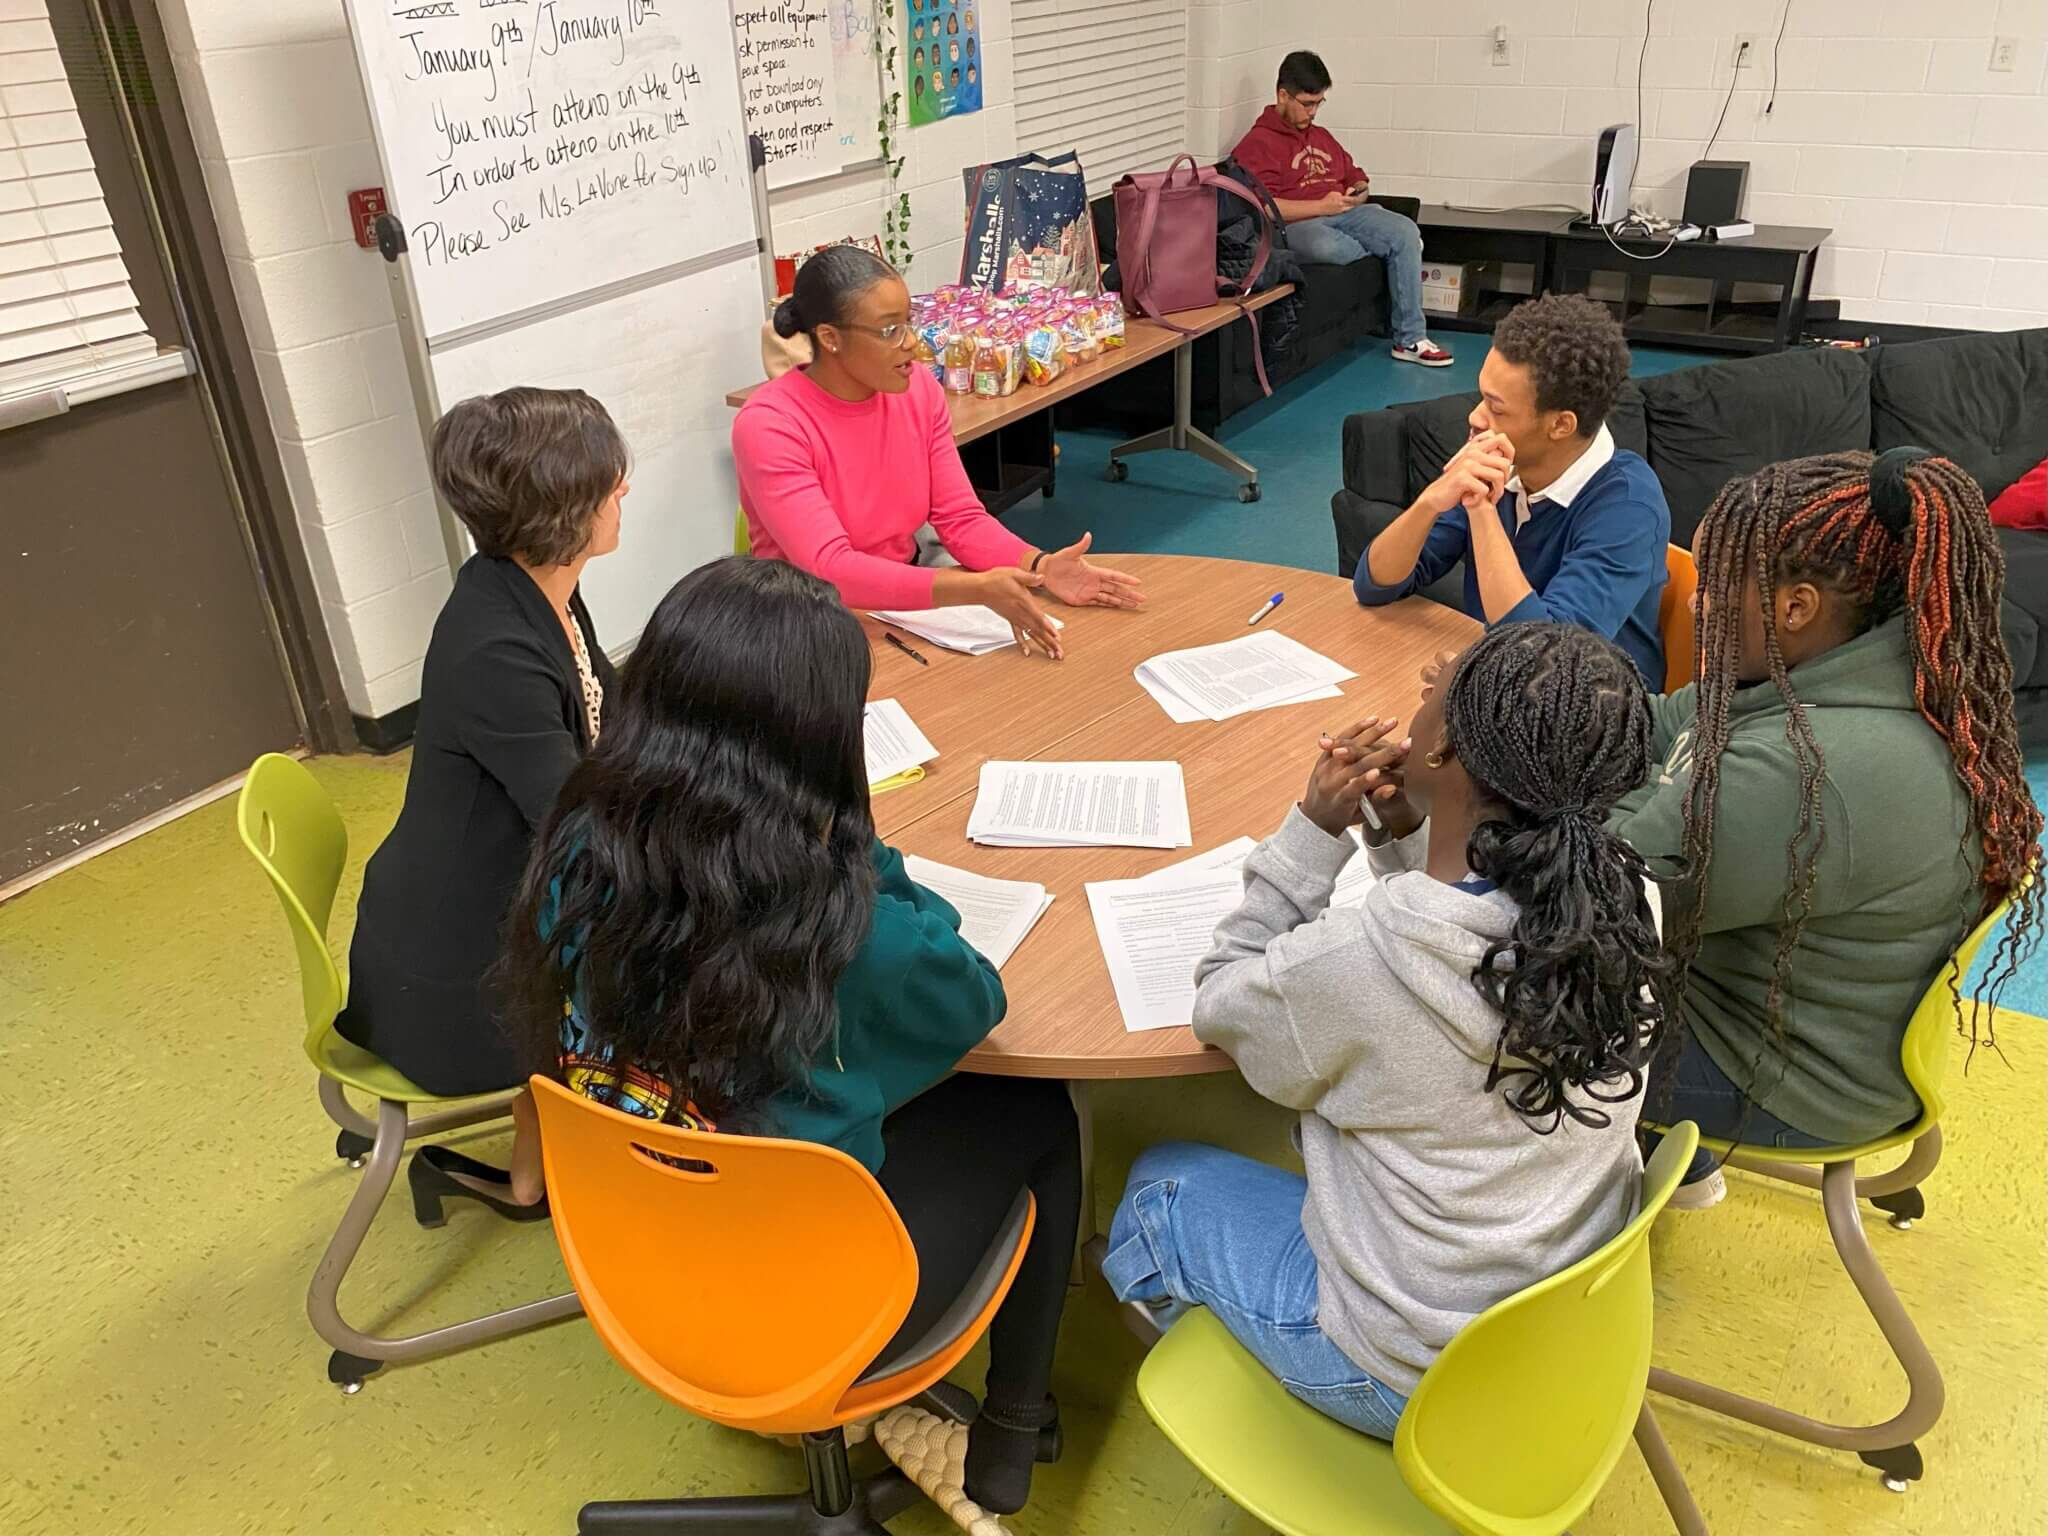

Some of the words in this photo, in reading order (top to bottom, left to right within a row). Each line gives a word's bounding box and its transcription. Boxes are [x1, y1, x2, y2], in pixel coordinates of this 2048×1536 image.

[735, 5, 768, 35] espect
[770, 4, 786, 25] all
[400, 31, 497, 102] January
[491, 18, 523, 67] 9th
[540, 0, 625, 66] January
[739, 37, 754, 58] sk
[802, 32, 815, 49] to
[741, 65, 760, 80] eave
[431, 98, 479, 162] You
[481, 87, 539, 138] must
[617, 85, 638, 110] on
[638, 72, 671, 101] the
[672, 62, 701, 101] 9th
[763, 103, 774, 115] on
[778, 121, 799, 140] and
[800, 116, 834, 142] respect
[426, 163, 468, 205] In
[473, 156, 516, 187] order
[519, 144, 540, 174] to
[607, 131, 628, 151] on
[628, 117, 660, 145] the
[411, 221, 491, 267] Please
[492, 199, 531, 242] See
[538, 183, 575, 219] Ms.
[633, 151, 657, 189] for
[660, 155, 695, 195] Sign
